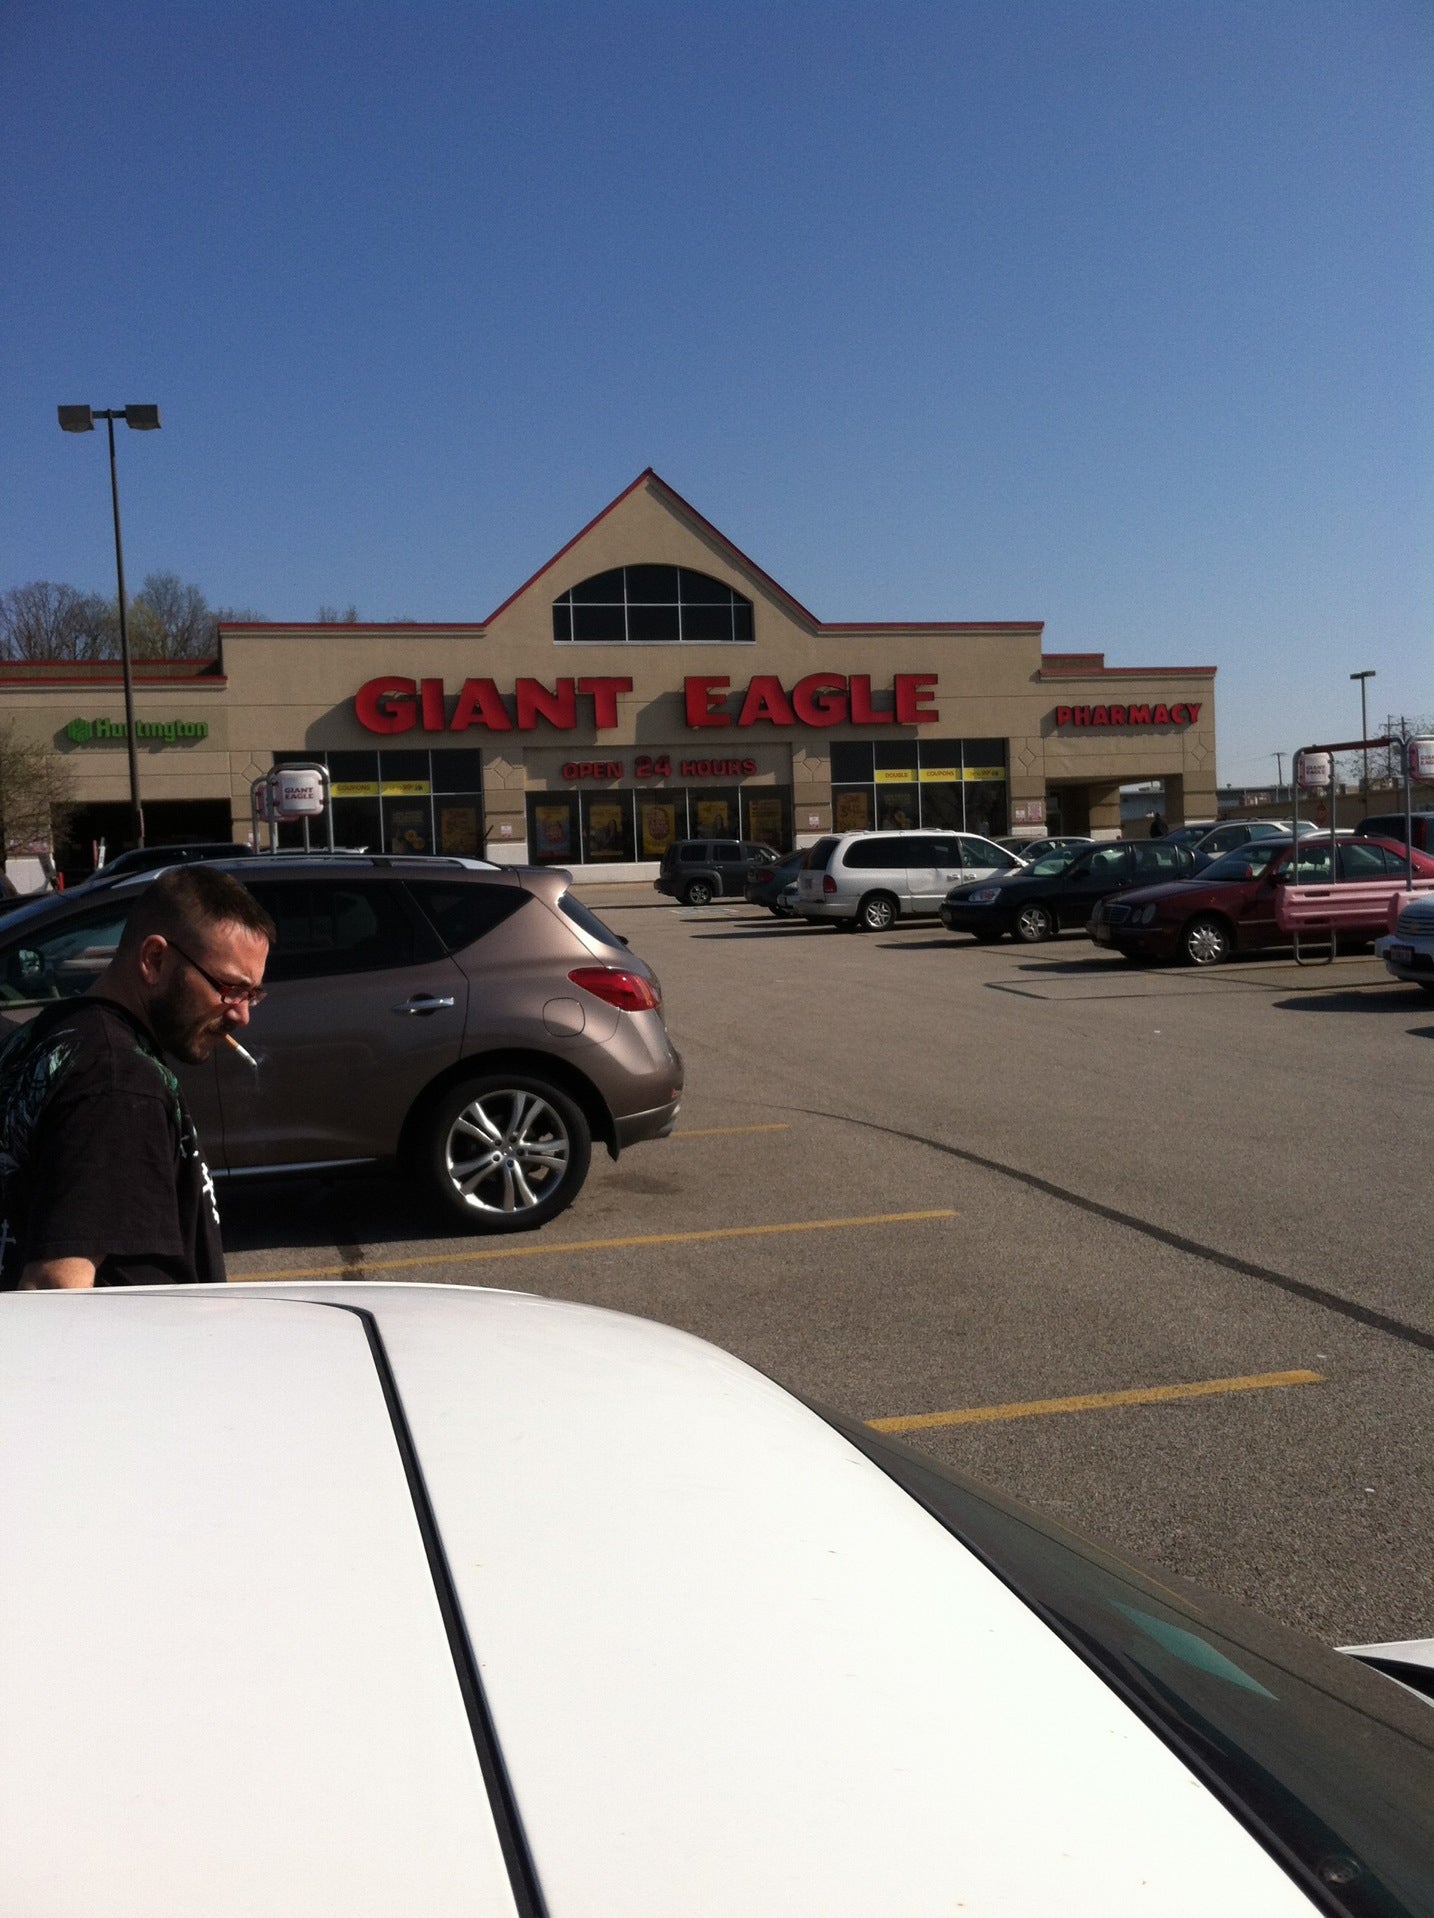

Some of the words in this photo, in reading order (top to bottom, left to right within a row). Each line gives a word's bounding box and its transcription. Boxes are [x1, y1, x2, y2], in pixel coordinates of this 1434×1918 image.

[354, 676, 633, 735] GIANT
[683, 672, 940, 728] EAGLE
[1055, 702, 1203, 727] PHARMACY
[562, 762, 624, 780] OPEN
[634, 755, 672, 778] 24
[681, 757, 757, 777] HOURS
